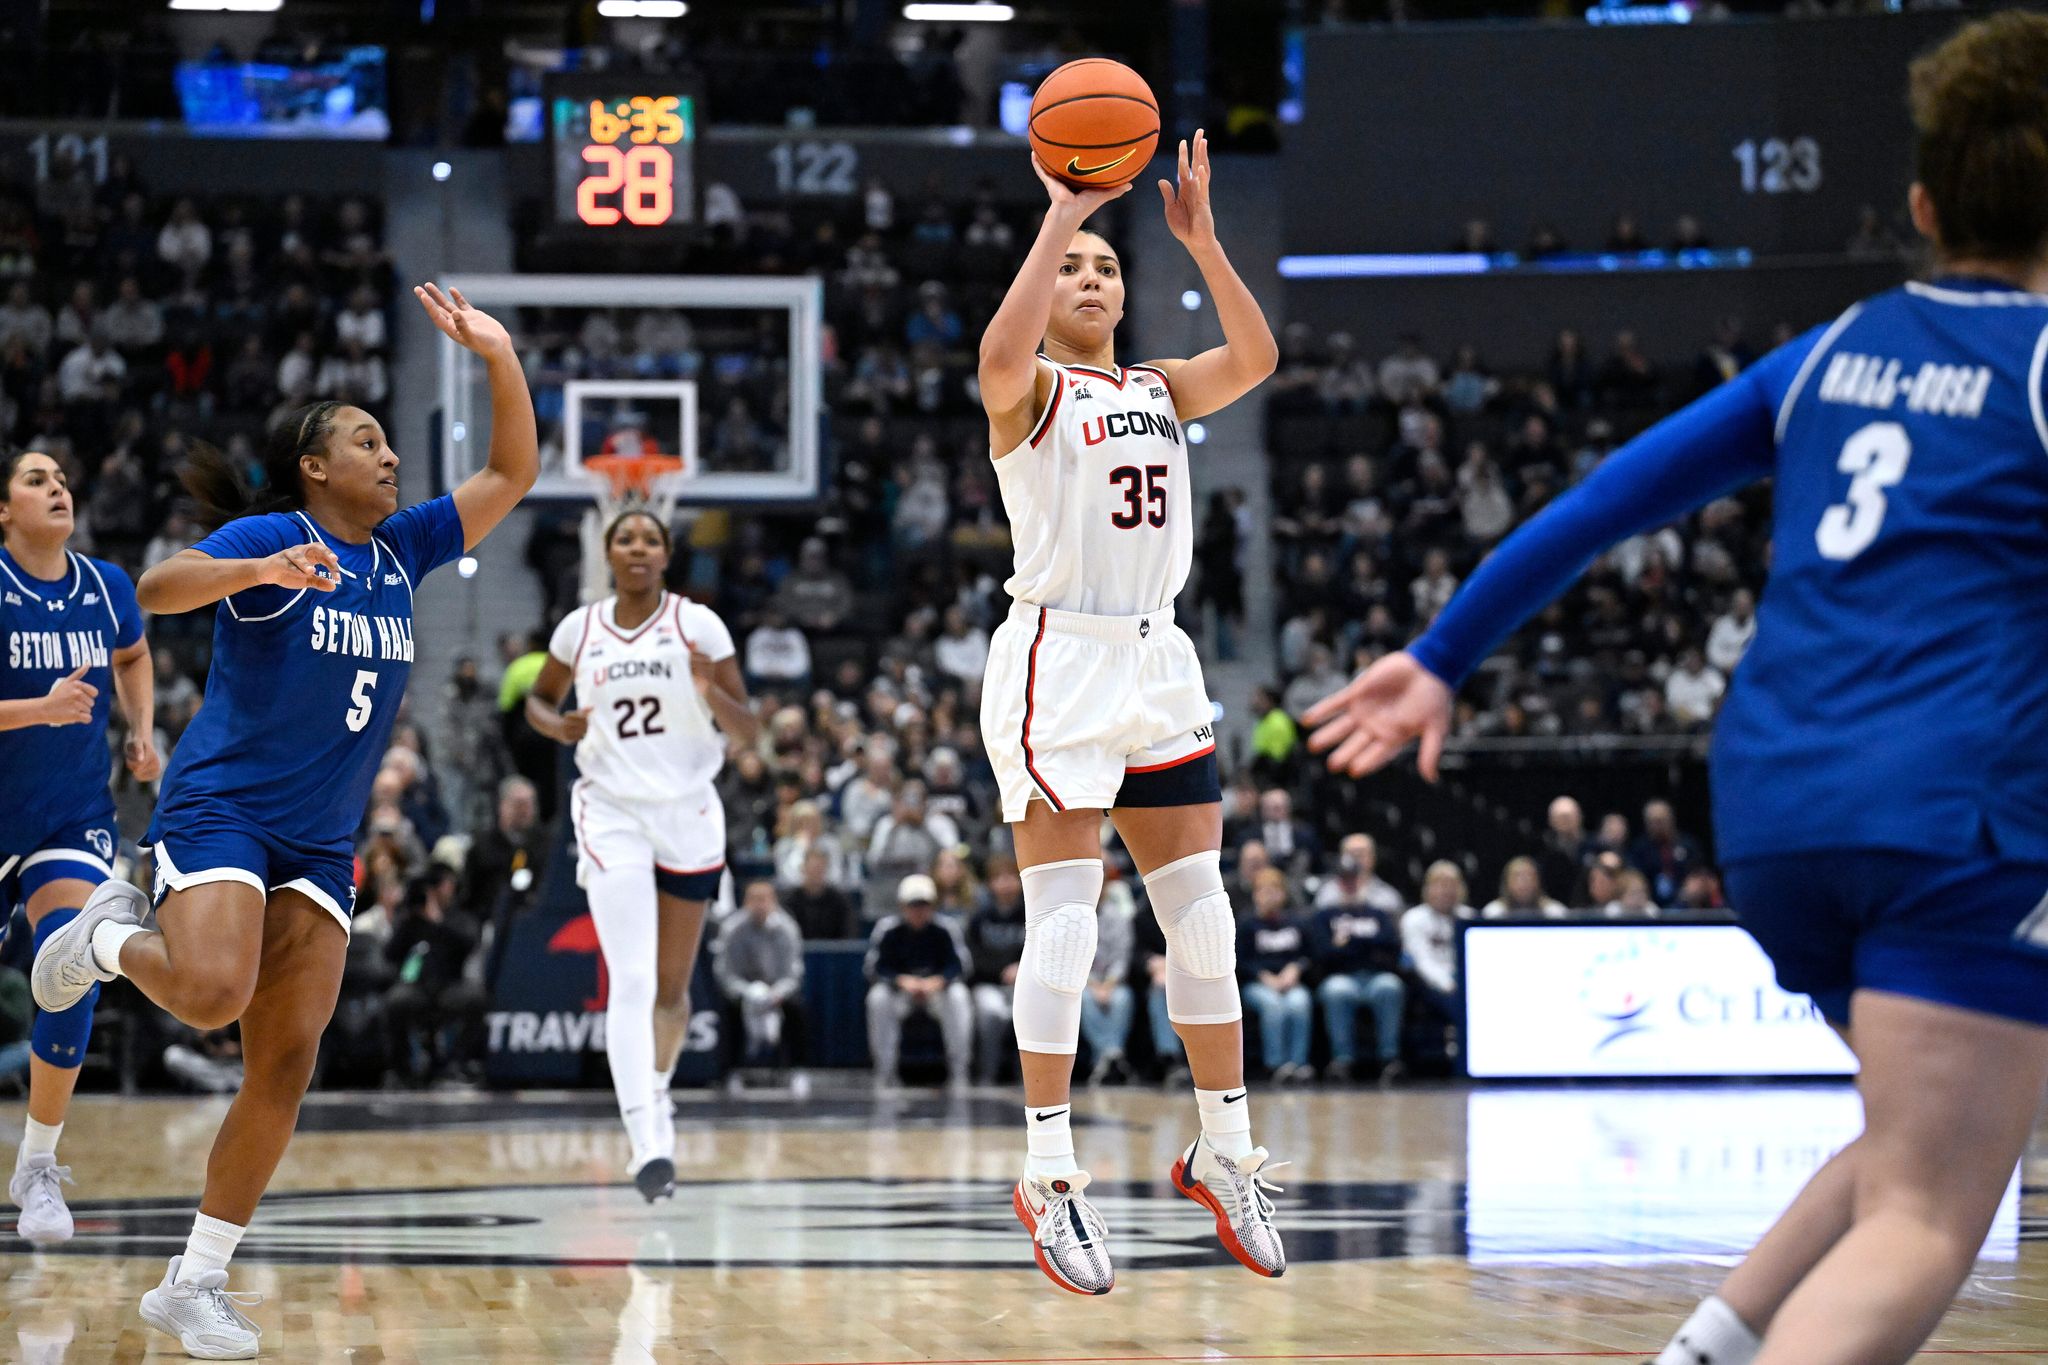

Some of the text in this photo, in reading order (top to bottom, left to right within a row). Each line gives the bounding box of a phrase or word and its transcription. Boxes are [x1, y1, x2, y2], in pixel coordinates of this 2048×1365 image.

[589, 95, 684, 144] 6:35
[577, 144, 673, 226] 28
[769, 143, 858, 193] 122
[1732, 137, 1822, 192] 123
[1082, 411, 1180, 446] UCONN
[1109, 464, 1168, 530] 35
[1814, 421, 1912, 562] 3
[9, 629, 109, 669] SETON HALL
[311, 605, 414, 663] SETON HALL
[594, 660, 672, 688] UCONN
[345, 669, 378, 732] 5
[613, 696, 665, 739] 22
